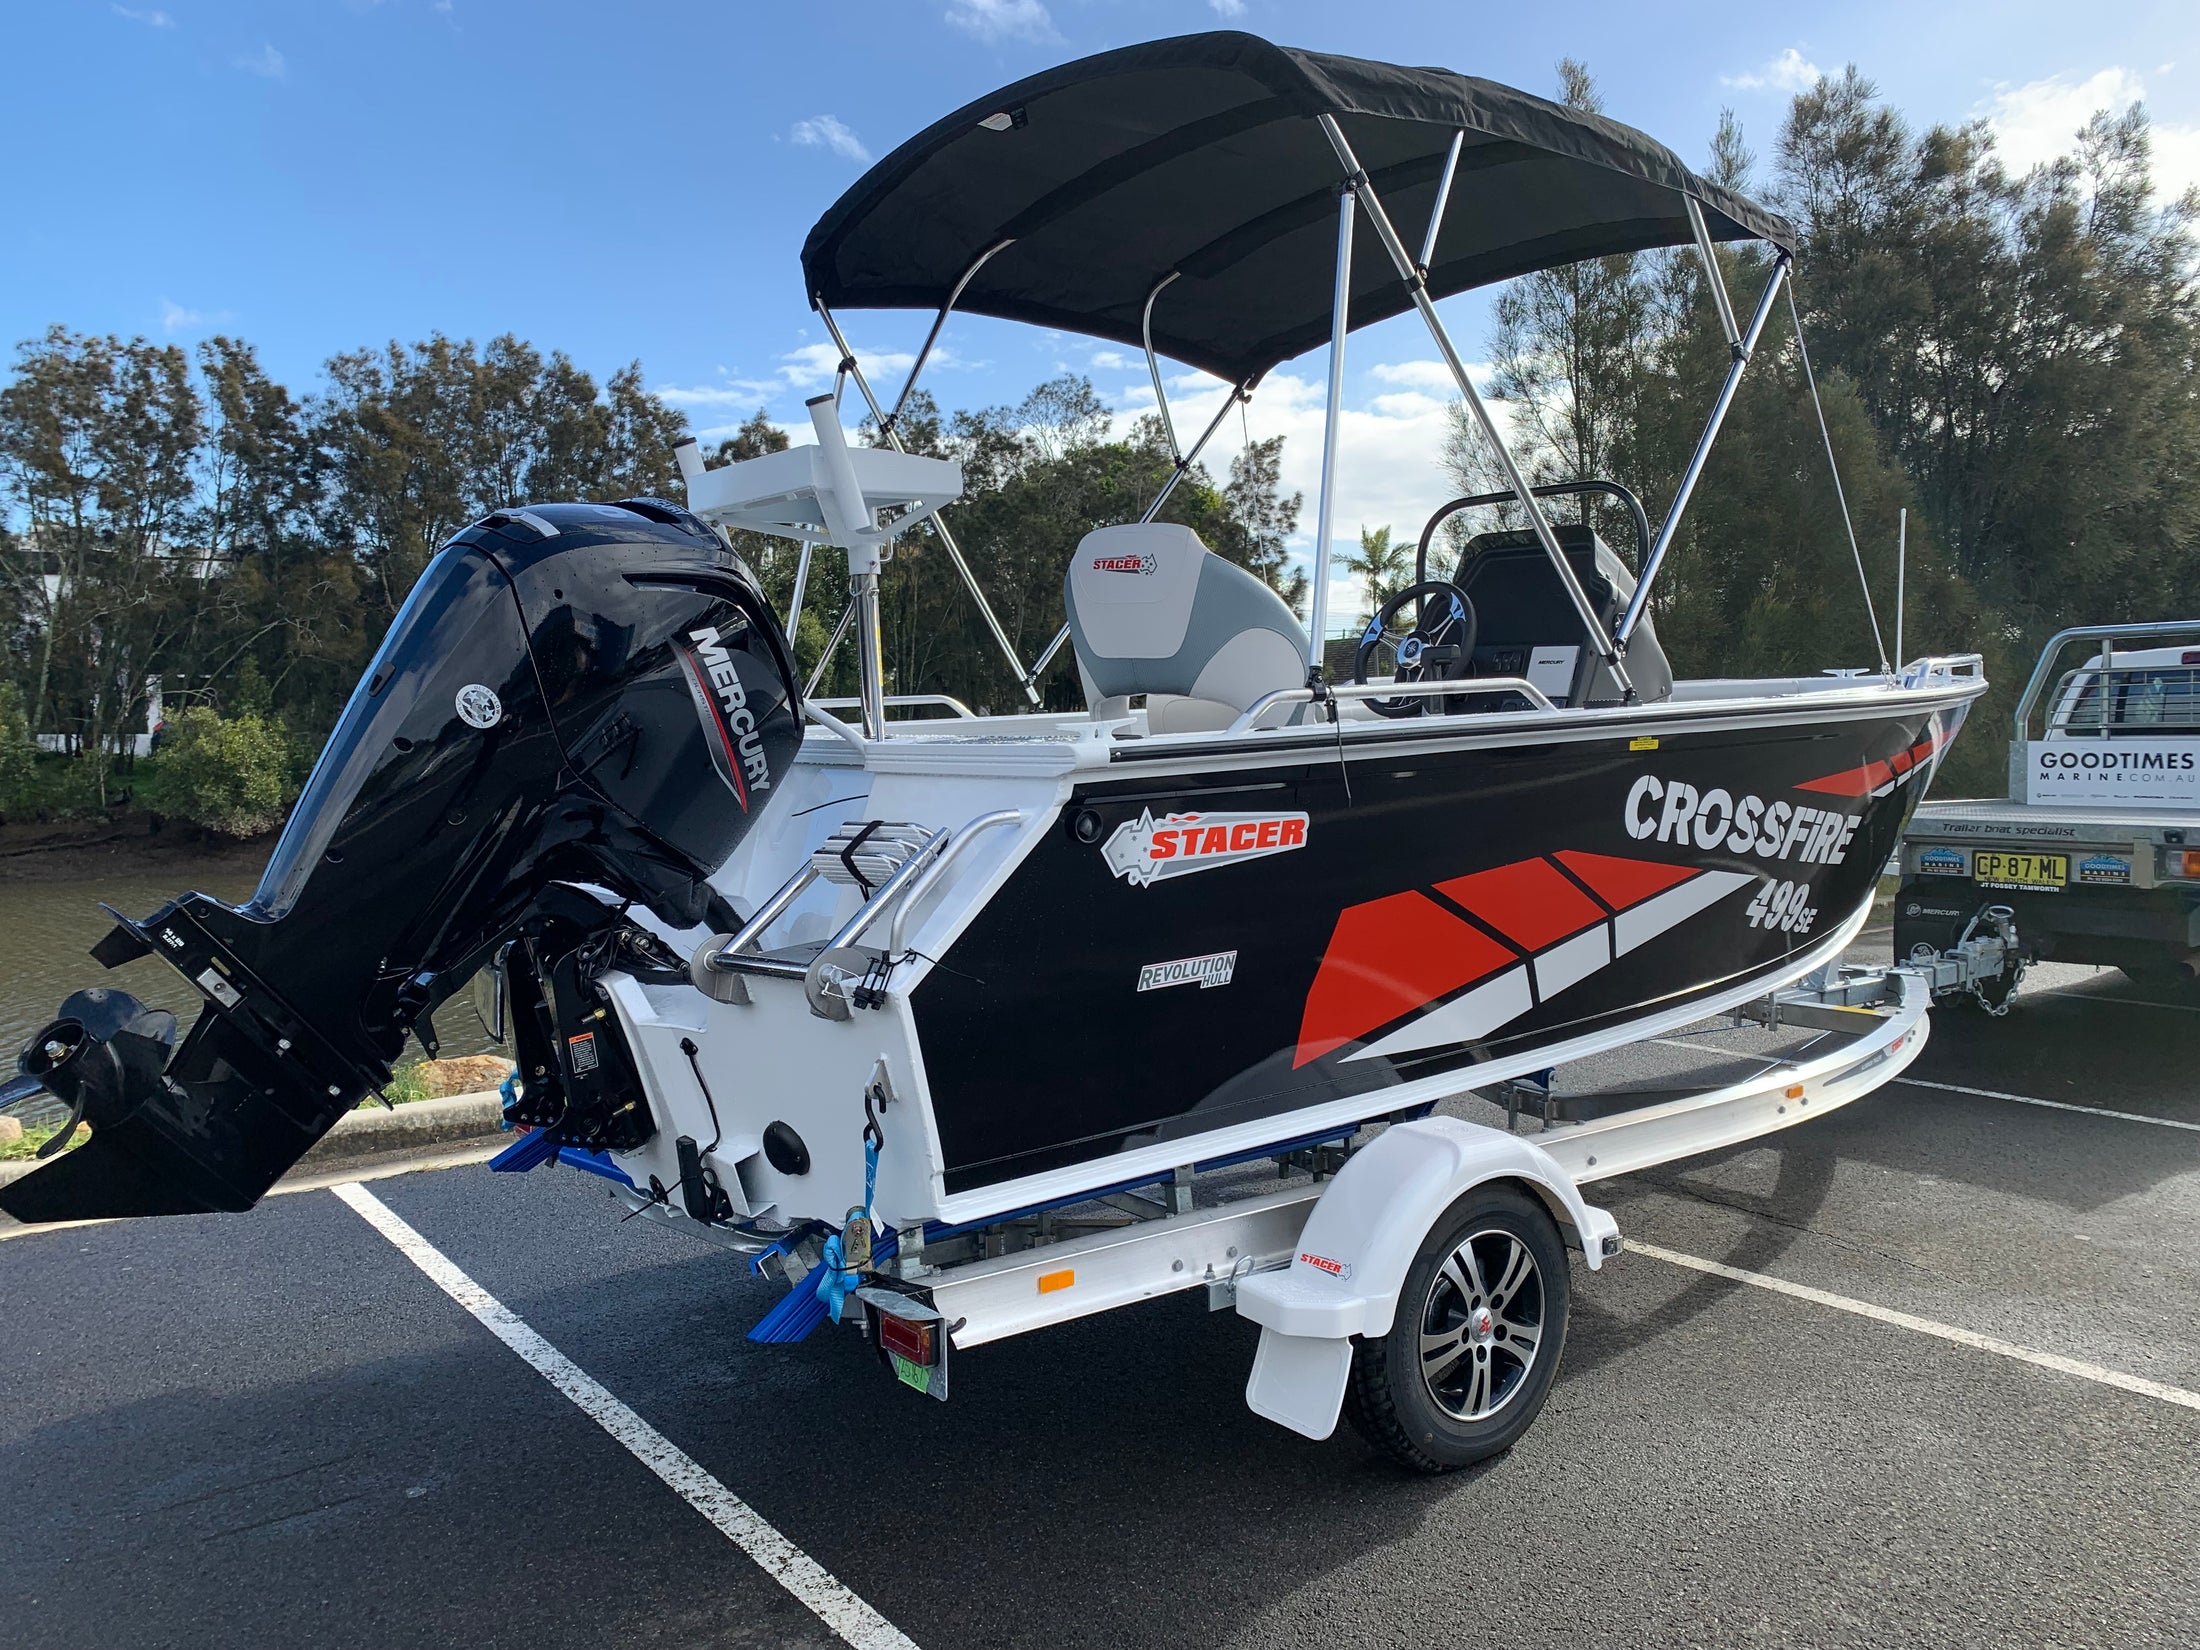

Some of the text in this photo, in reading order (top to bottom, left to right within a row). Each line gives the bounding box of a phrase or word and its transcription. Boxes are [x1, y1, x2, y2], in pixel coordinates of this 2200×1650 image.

[1093, 559, 1141, 570] STACER
[688, 626, 770, 792] MERCURY
[2040, 752, 2195, 770] GOODTIMES
[1624, 774, 1862, 865] CROSSFIRE
[1149, 818, 1306, 860] STACER
[1985, 825, 2011, 834] boat
[2015, 826, 2076, 837] specialist
[2019, 884, 2060, 893] TAMWORTH
[1138, 954, 1236, 990] REVOLUTION
[1201, 971, 1230, 987] HULL
[1300, 1253, 1342, 1273] STACER
